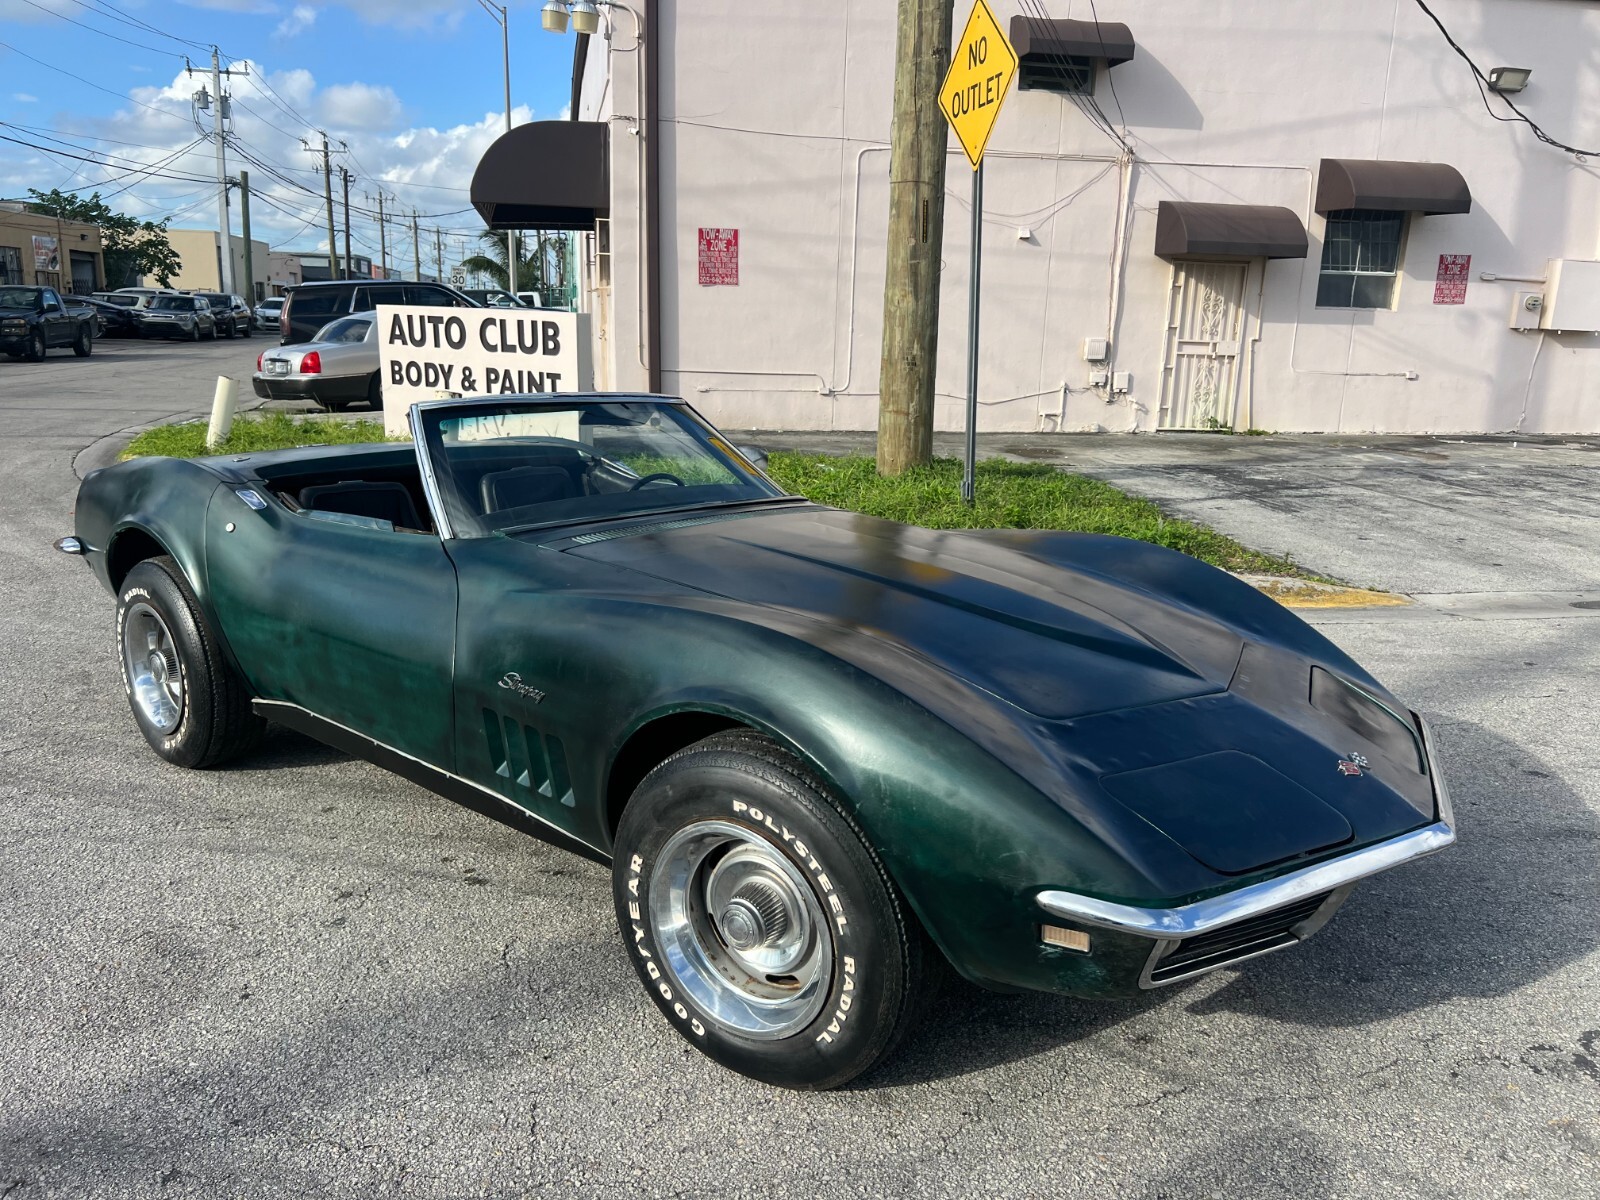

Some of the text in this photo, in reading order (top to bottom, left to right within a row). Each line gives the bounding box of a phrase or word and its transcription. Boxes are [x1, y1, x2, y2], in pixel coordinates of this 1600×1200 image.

[968, 36, 987, 70] NO
[952, 72, 1003, 118] OUTLET
[702, 228, 735, 240] TOW-AWAY
[711, 240, 727, 251] ZONE
[452, 275, 465, 284] 30
[1447, 264, 1462, 274] ZONE
[389, 313, 561, 356] AUTO CLUB
[390, 360, 562, 394] BODY & PAINT
[124, 587, 150, 602] RADIAL
[497, 672, 546, 704] Stingray
[732, 800, 850, 936] POLYSTEEL
[627, 853, 706, 1037] GOODYEAR
[815, 955, 857, 1044] RADIAL
